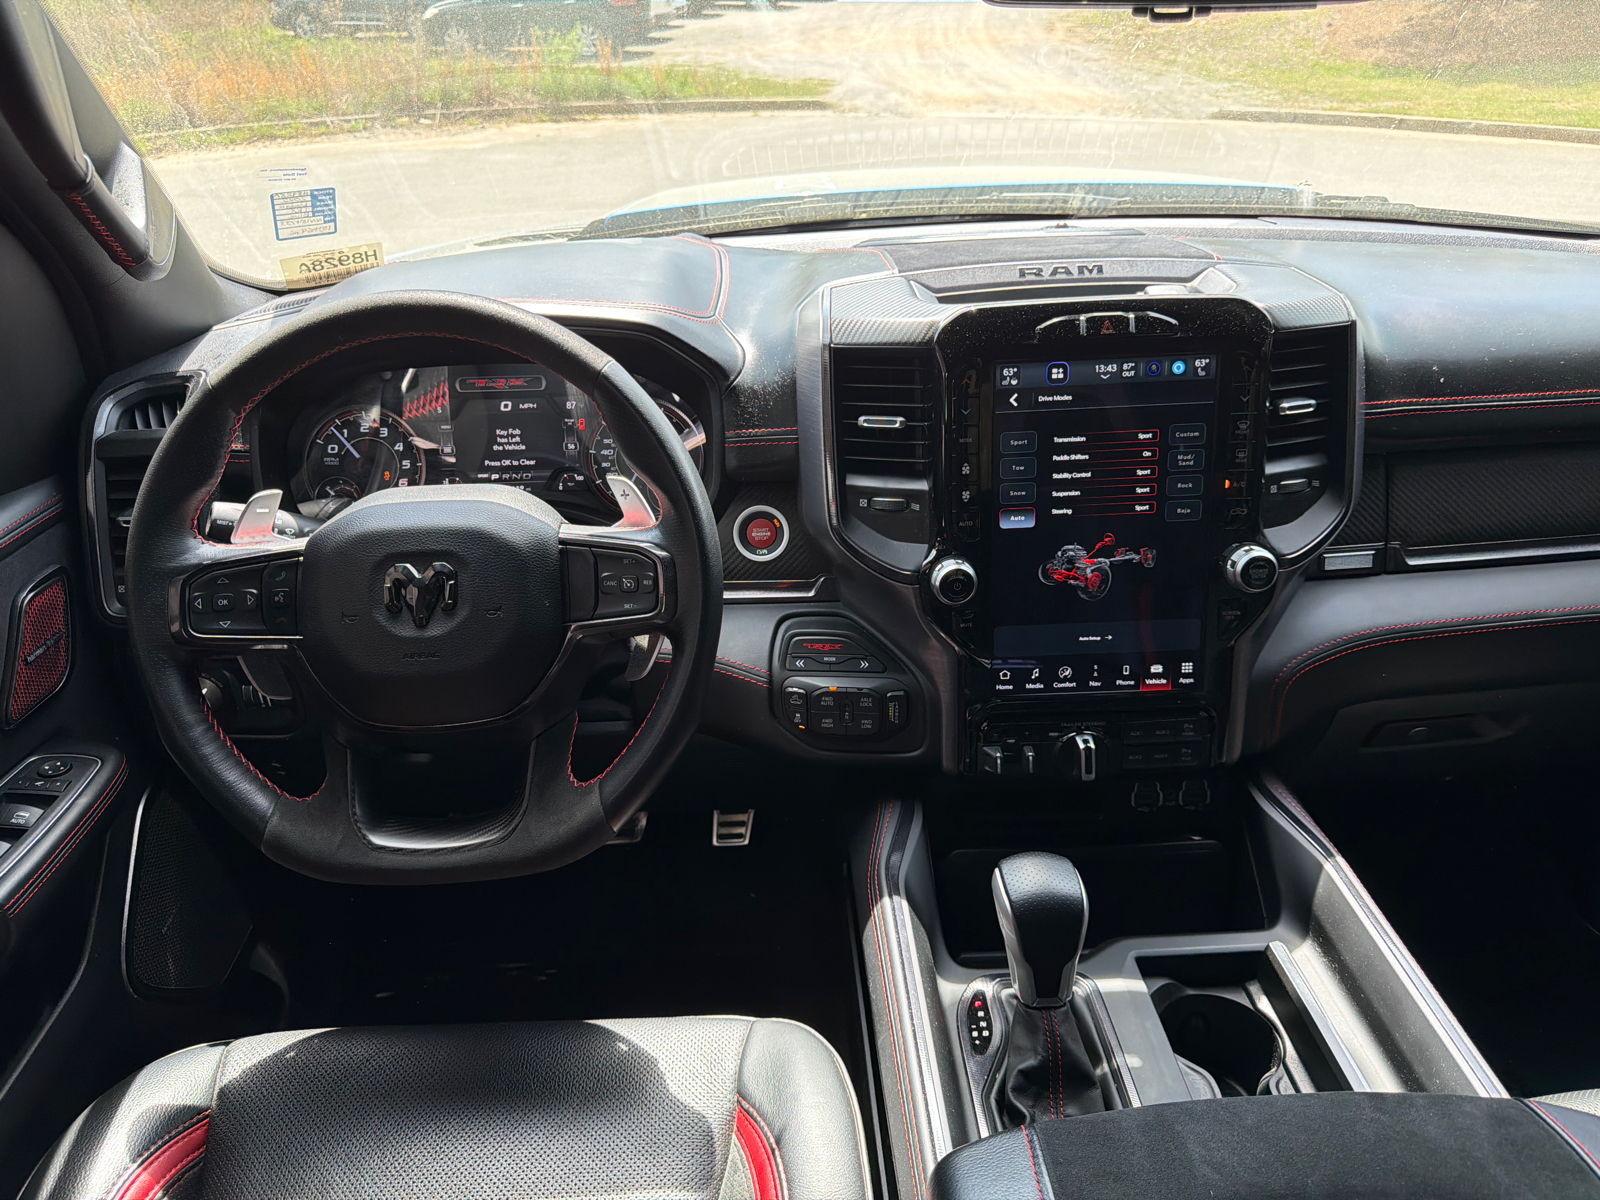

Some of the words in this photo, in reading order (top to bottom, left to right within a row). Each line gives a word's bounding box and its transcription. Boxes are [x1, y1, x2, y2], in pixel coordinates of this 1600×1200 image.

[1018, 264, 1103, 279] RAM
[1095, 364, 1117, 372] 13:43
[500, 401, 512, 411] 0
[360, 424, 370, 432] 2
[342, 429, 348, 437] 1
[379, 428, 388, 437] 3
[327, 444, 338, 453] 0
[394, 443, 403, 451] 4
[402, 460, 410, 468] 5
[402, 652, 441, 660] AIRBAG
